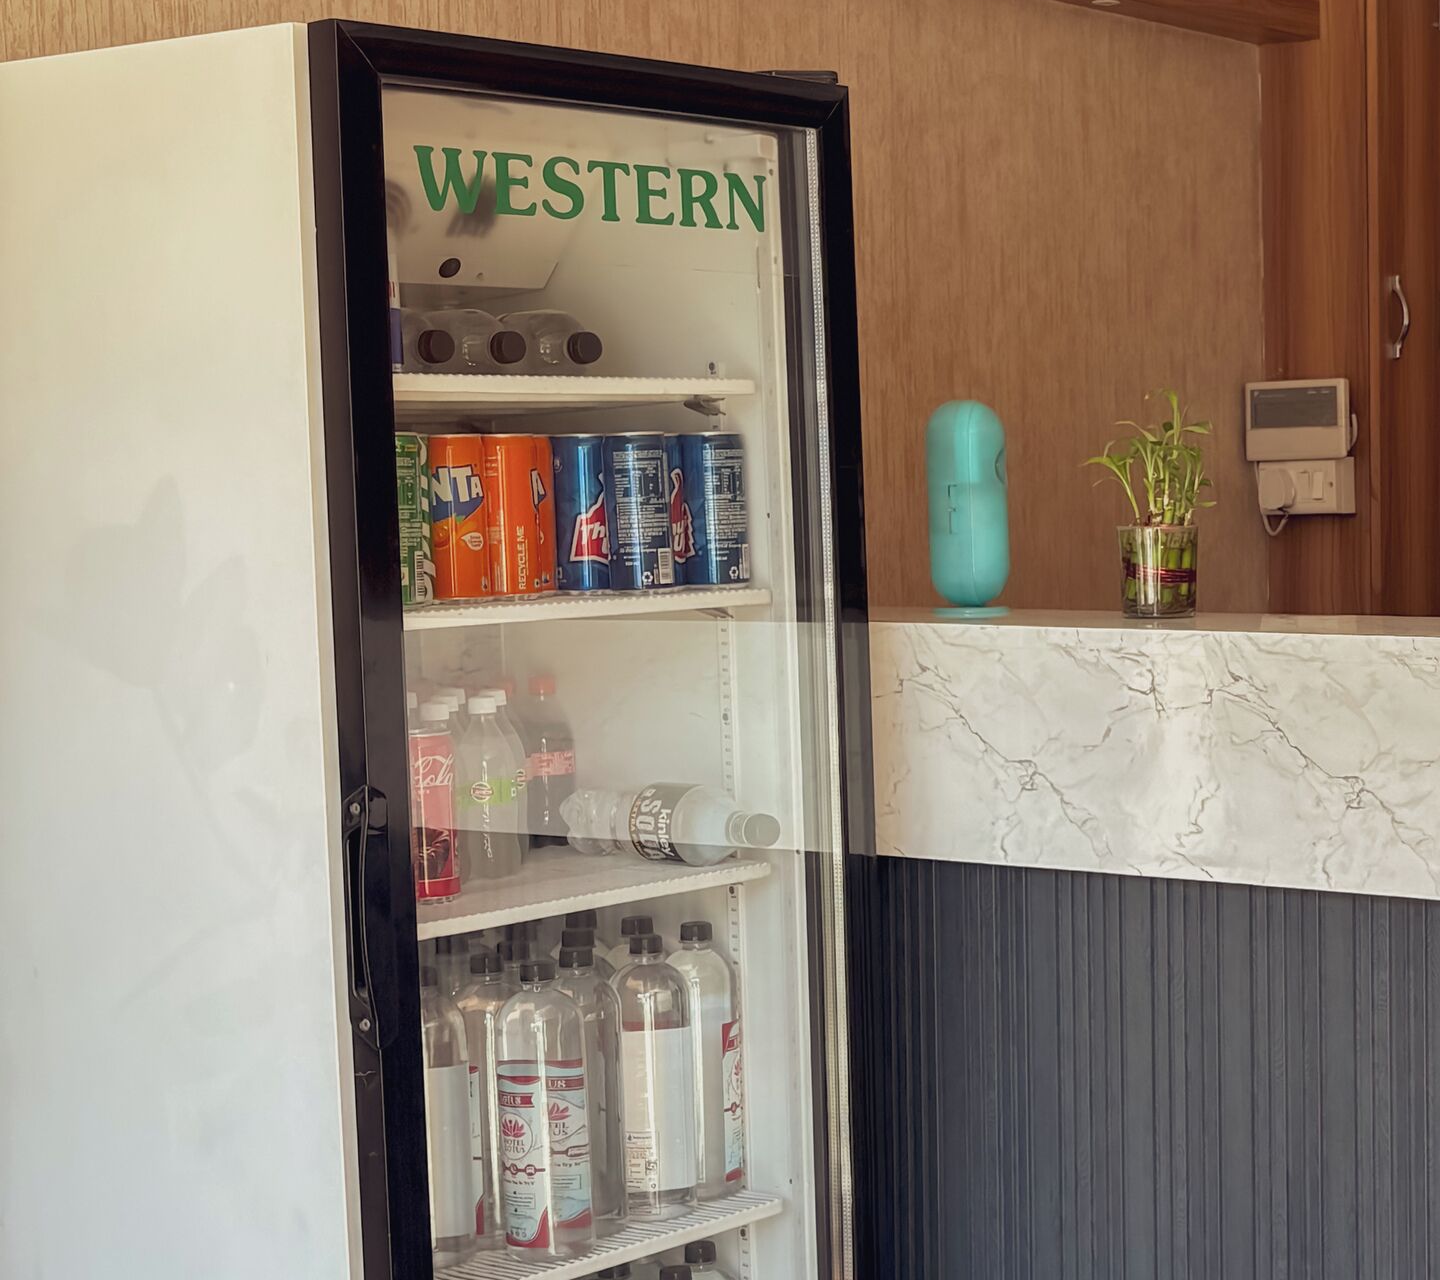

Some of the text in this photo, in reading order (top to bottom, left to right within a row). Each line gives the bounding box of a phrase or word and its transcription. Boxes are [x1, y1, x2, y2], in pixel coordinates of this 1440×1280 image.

[413, 145, 766, 232] WESTERN
[432, 466, 484, 506] NTA
[518, 543, 526, 589] RECYCLE
